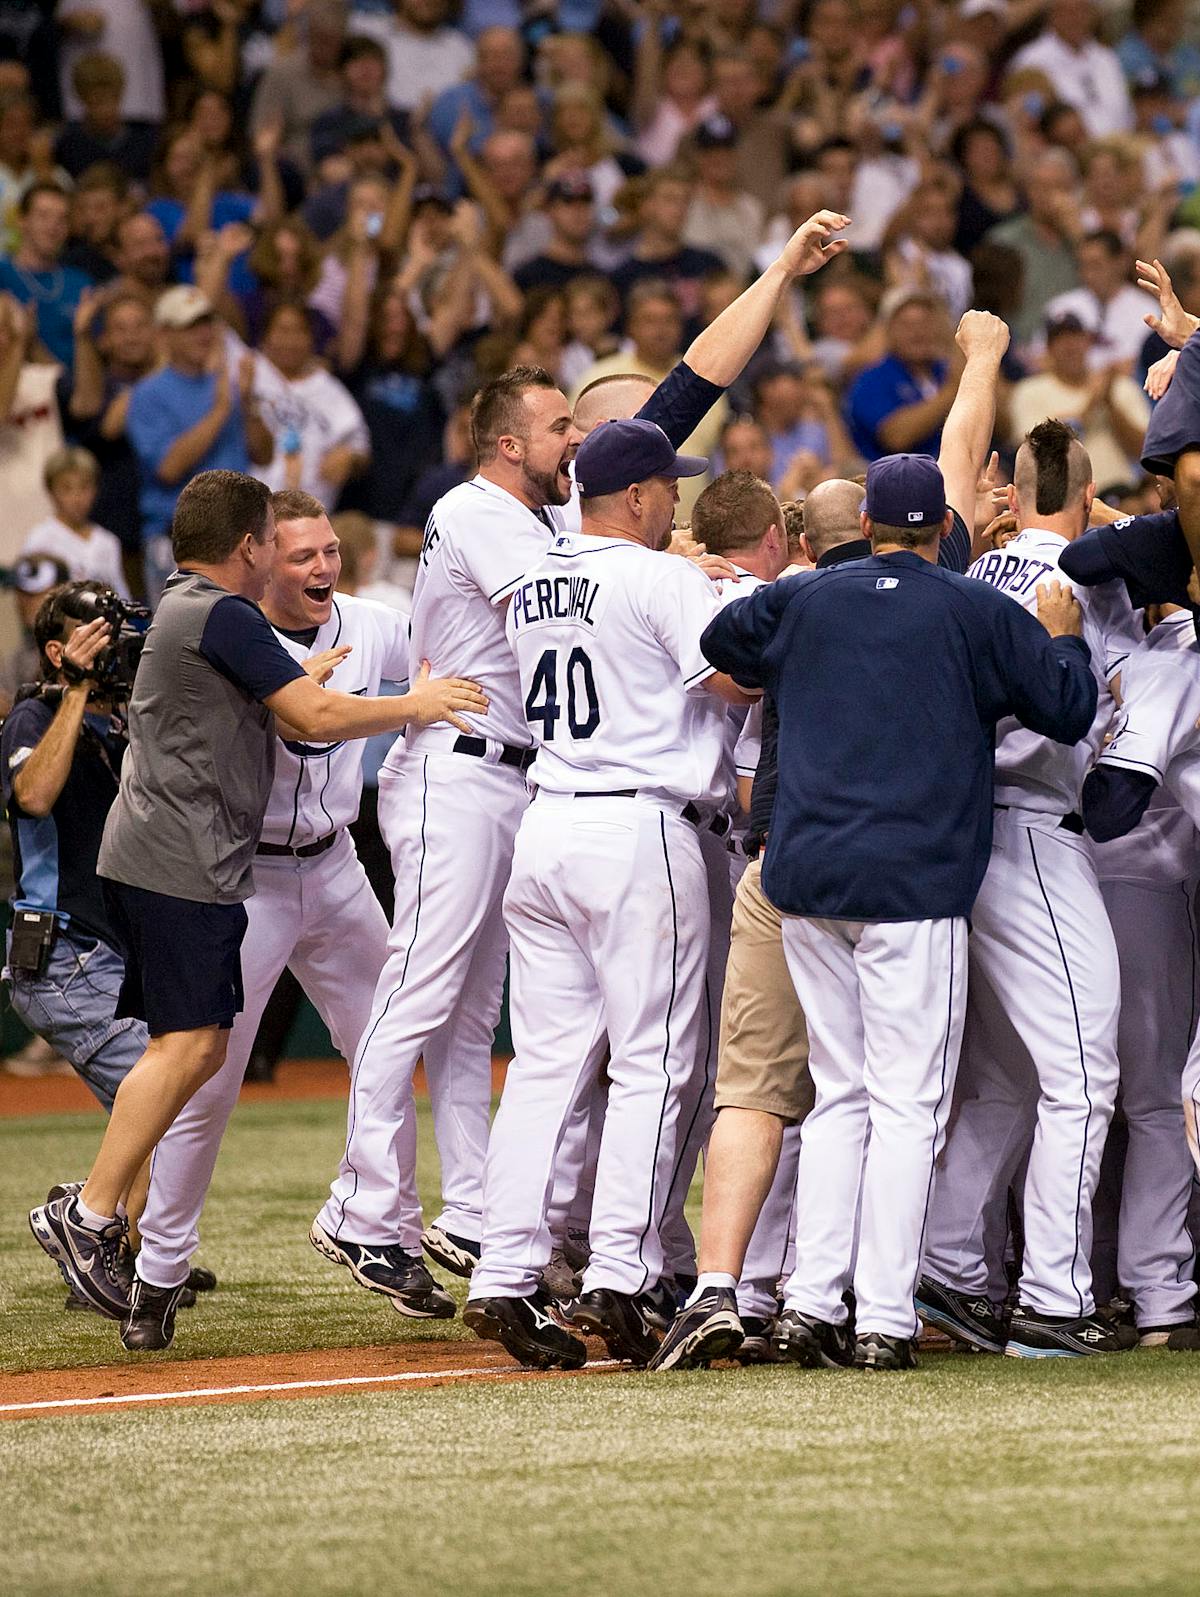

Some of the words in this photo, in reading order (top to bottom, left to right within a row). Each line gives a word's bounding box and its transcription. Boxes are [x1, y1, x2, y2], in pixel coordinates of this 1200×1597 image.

[969, 554, 1055, 596] OBRIST
[513, 576, 600, 630] PERCIVAL
[525, 646, 601, 741] 40
